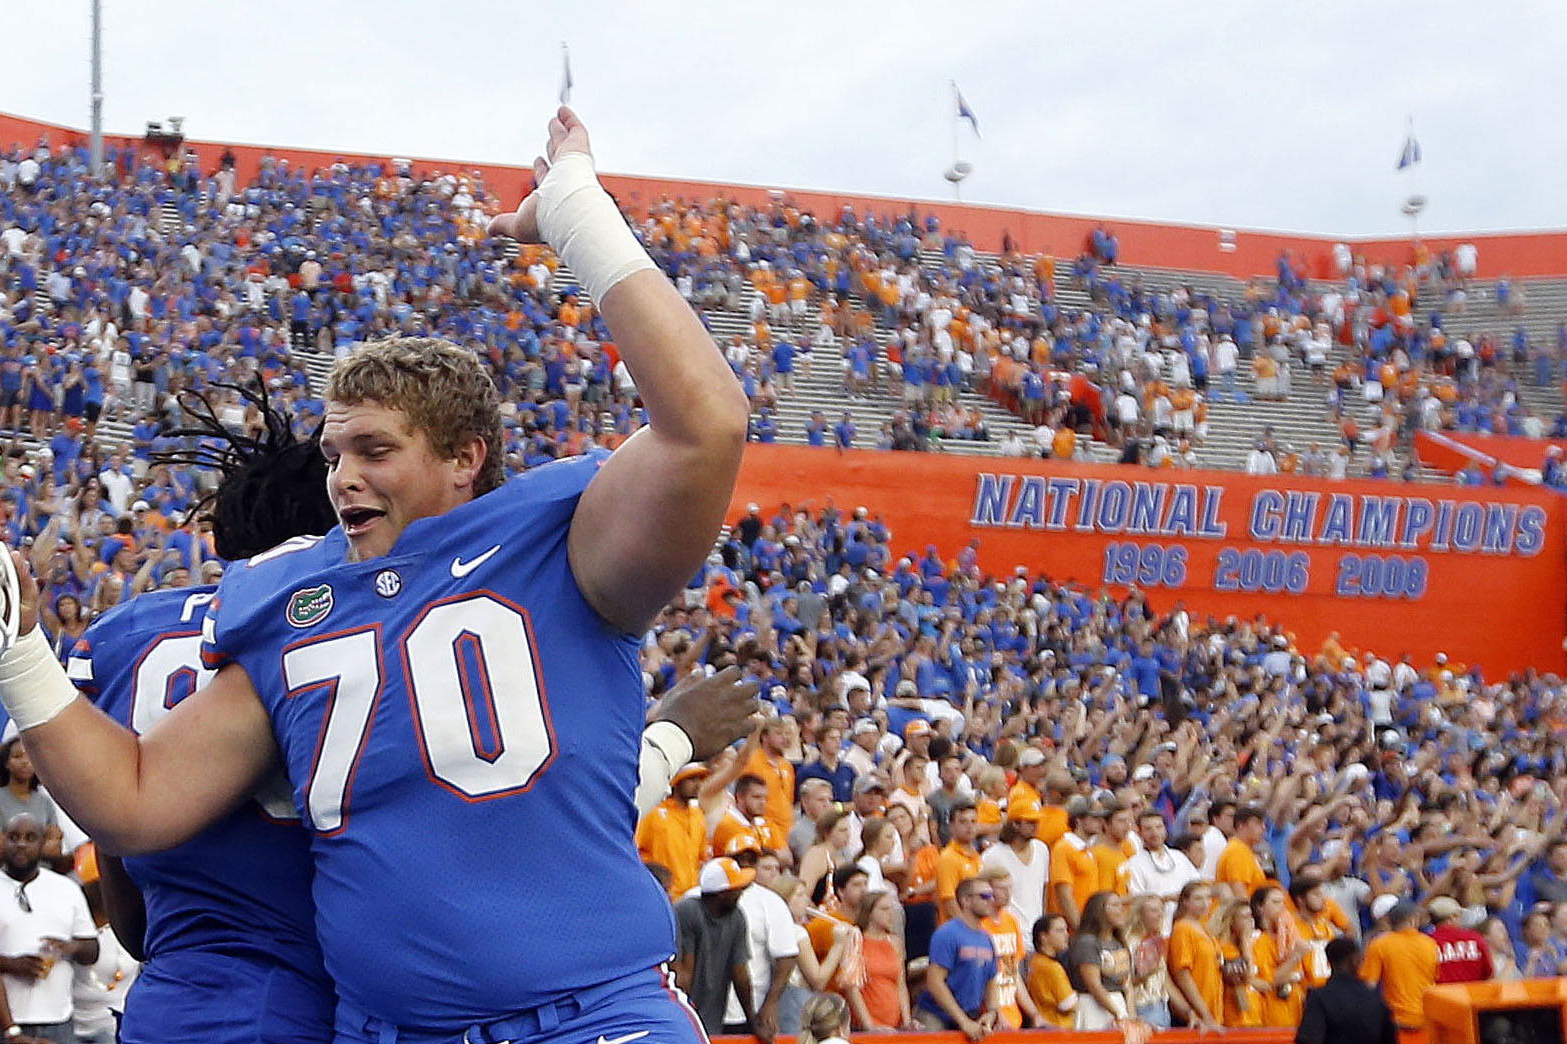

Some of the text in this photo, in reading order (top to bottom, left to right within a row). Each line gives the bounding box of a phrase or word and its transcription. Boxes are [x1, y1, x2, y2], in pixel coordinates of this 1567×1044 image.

[970, 472, 1547, 556] NATIONAL CHAMPIONS
[375, 570, 401, 597] SEC
[1103, 542, 1429, 601] 1996 2006 2008
[280, 588, 559, 836] 70
